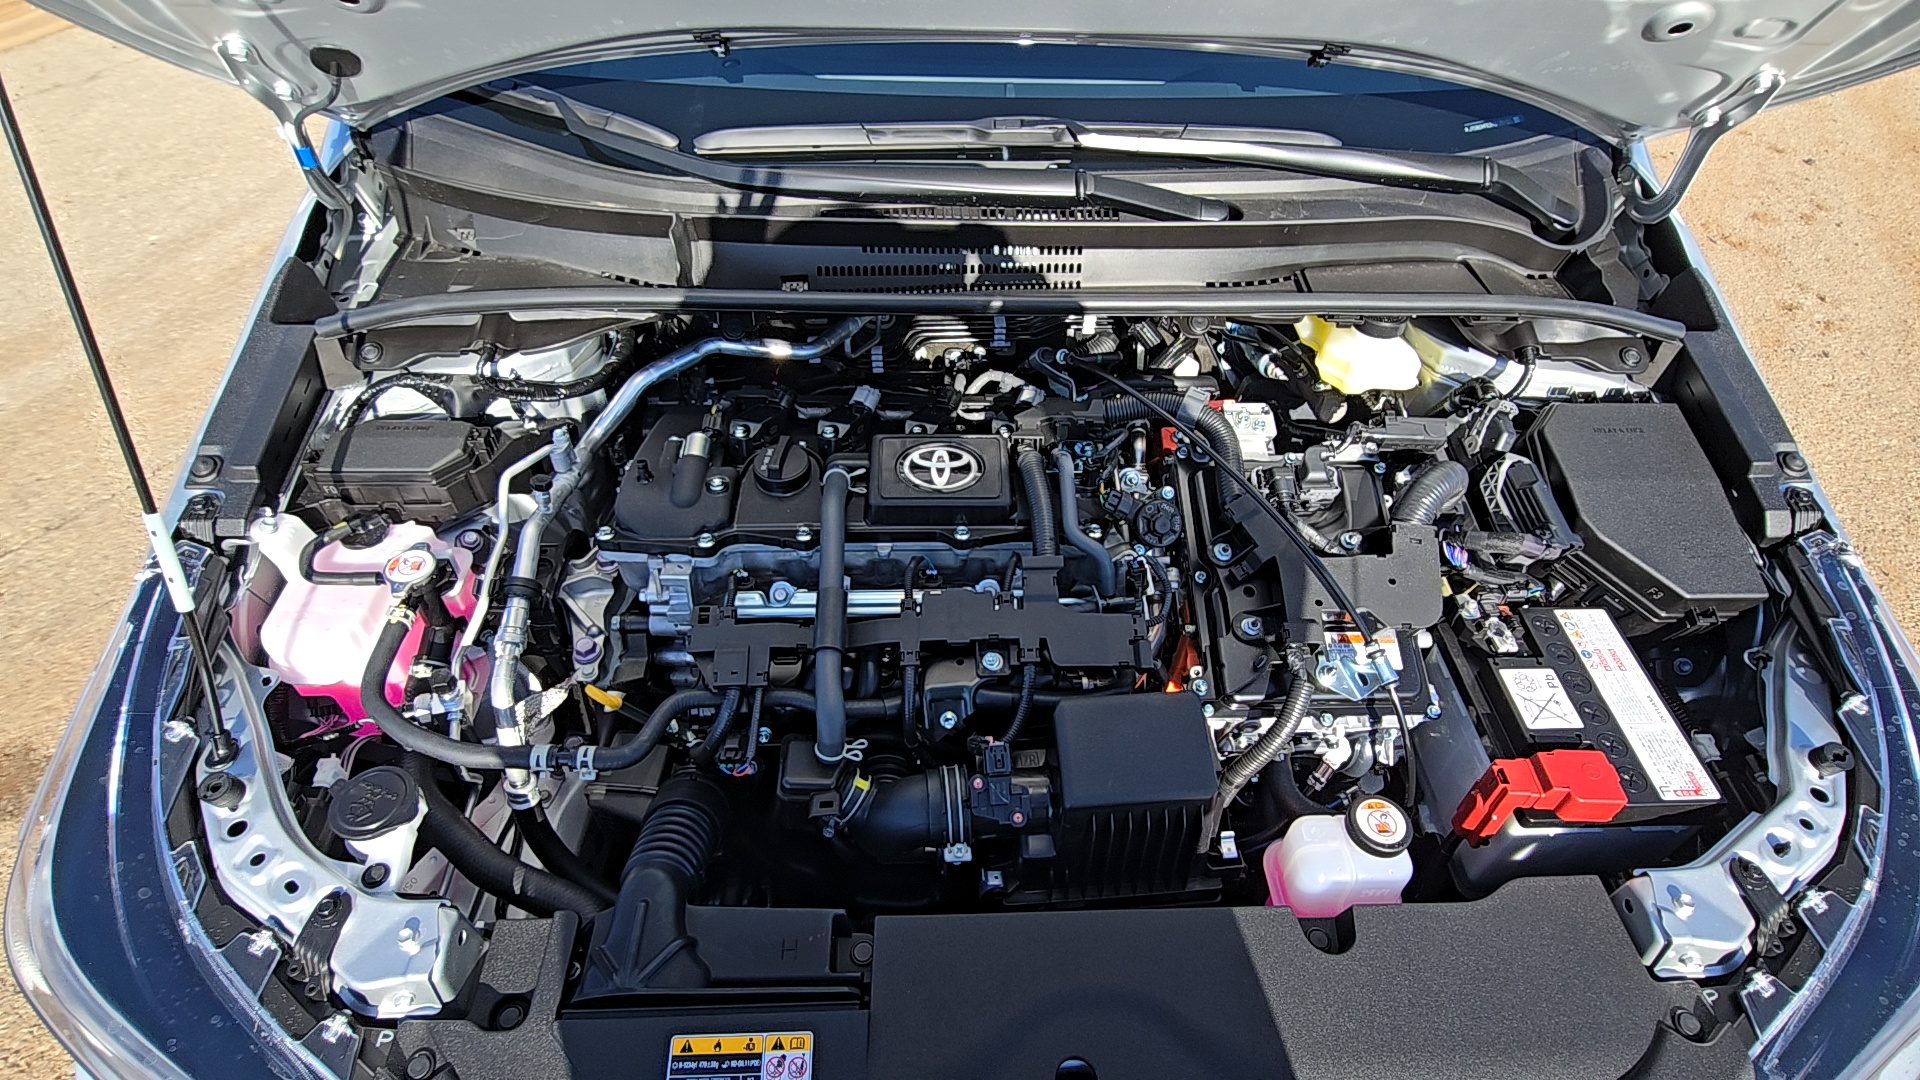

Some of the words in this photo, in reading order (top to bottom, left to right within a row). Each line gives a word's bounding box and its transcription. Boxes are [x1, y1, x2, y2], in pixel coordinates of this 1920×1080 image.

[1646, 586, 1664, 600] F3
[1544, 674, 1560, 688] Pb
[781, 938, 798, 960] H
[1702, 989, 1719, 1006] P
[375, 1030, 395, 1048] P
